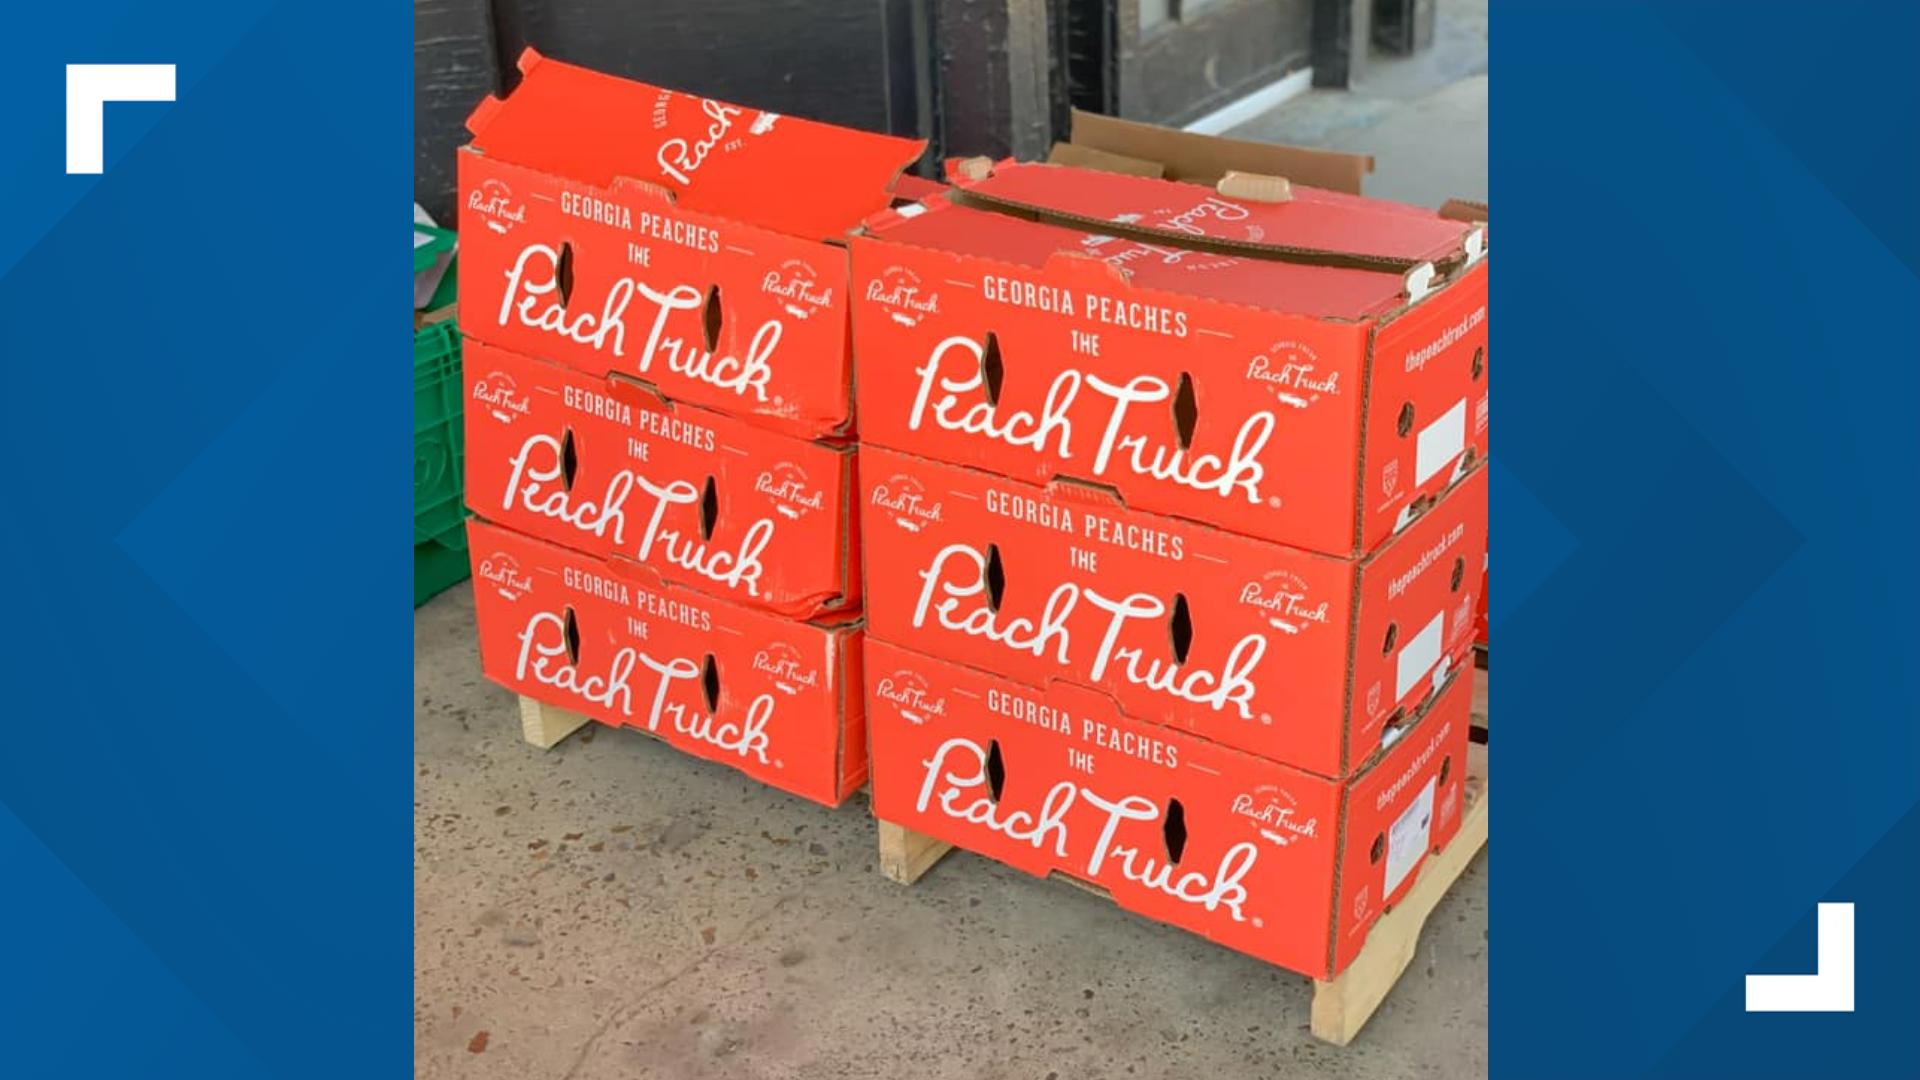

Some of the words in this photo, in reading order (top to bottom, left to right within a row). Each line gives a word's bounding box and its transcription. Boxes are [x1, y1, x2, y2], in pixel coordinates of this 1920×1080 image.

[656, 97, 741, 185] Peach
[560, 190, 632, 231] GEORGIA
[640, 212, 719, 253] PEACHES
[627, 243, 650, 268] THE
[498, 243, 634, 357] Peach
[636, 284, 782, 402] Truck
[985, 274, 1074, 317] GEORGIA
[1085, 294, 1188, 338] PEACHES
[1071, 330, 1100, 357] THE
[563, 385, 632, 427] GEORGIA
[640, 410, 715, 453] PEACHES
[627, 437, 650, 462] THE
[908, 335, 1082, 459] Peach
[1085, 373, 1276, 505] Truck
[502, 434, 633, 545] Peach
[637, 475, 775, 597] Truck
[985, 488, 1073, 534] GEORGIA
[1084, 515, 1184, 561] PEACHES
[1069, 546, 1098, 573] THE
[563, 566, 630, 606] GEORGIA
[637, 591, 712, 633] PEACHES
[627, 617, 649, 641] THE
[912, 543, 1079, 665] Peach
[1083, 588, 1267, 720] Truck
[516, 611, 632, 716] Peach
[639, 652, 775, 766] Truck
[987, 688, 1072, 736] GEORGIA
[1083, 721, 1179, 768] PEACHES
[1068, 746, 1095, 775] THE
[915, 736, 1078, 859] Peach
[1080, 788, 1260, 923] Truck
